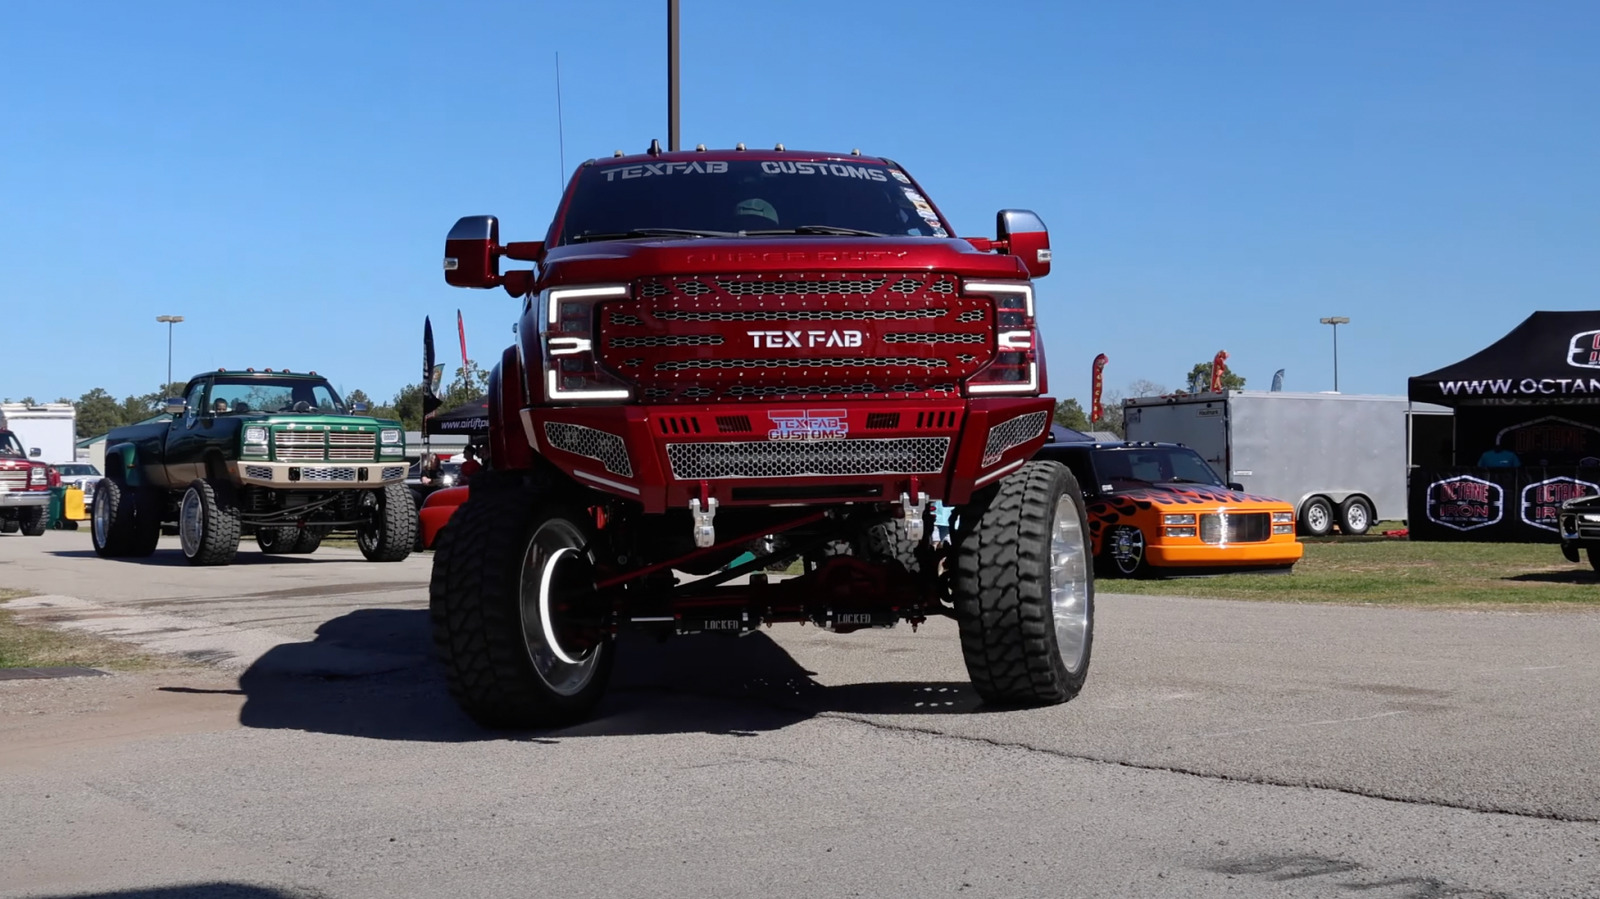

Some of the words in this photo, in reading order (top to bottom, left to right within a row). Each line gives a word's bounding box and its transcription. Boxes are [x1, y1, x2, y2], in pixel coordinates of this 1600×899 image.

[600, 160, 729, 182] TEXFAB
[760, 161, 888, 182] CUSTOMS
[746, 330, 802, 348] TEX
[807, 329, 862, 348] FAB
[768, 429, 846, 440] CUSTOMS
[1441, 482, 1489, 503] OCTANE
[1440, 504, 1489, 517] IRON
[1535, 506, 1557, 519] IR
[704, 619, 739, 631] LOCKED
[837, 613, 872, 625] LOCKED
